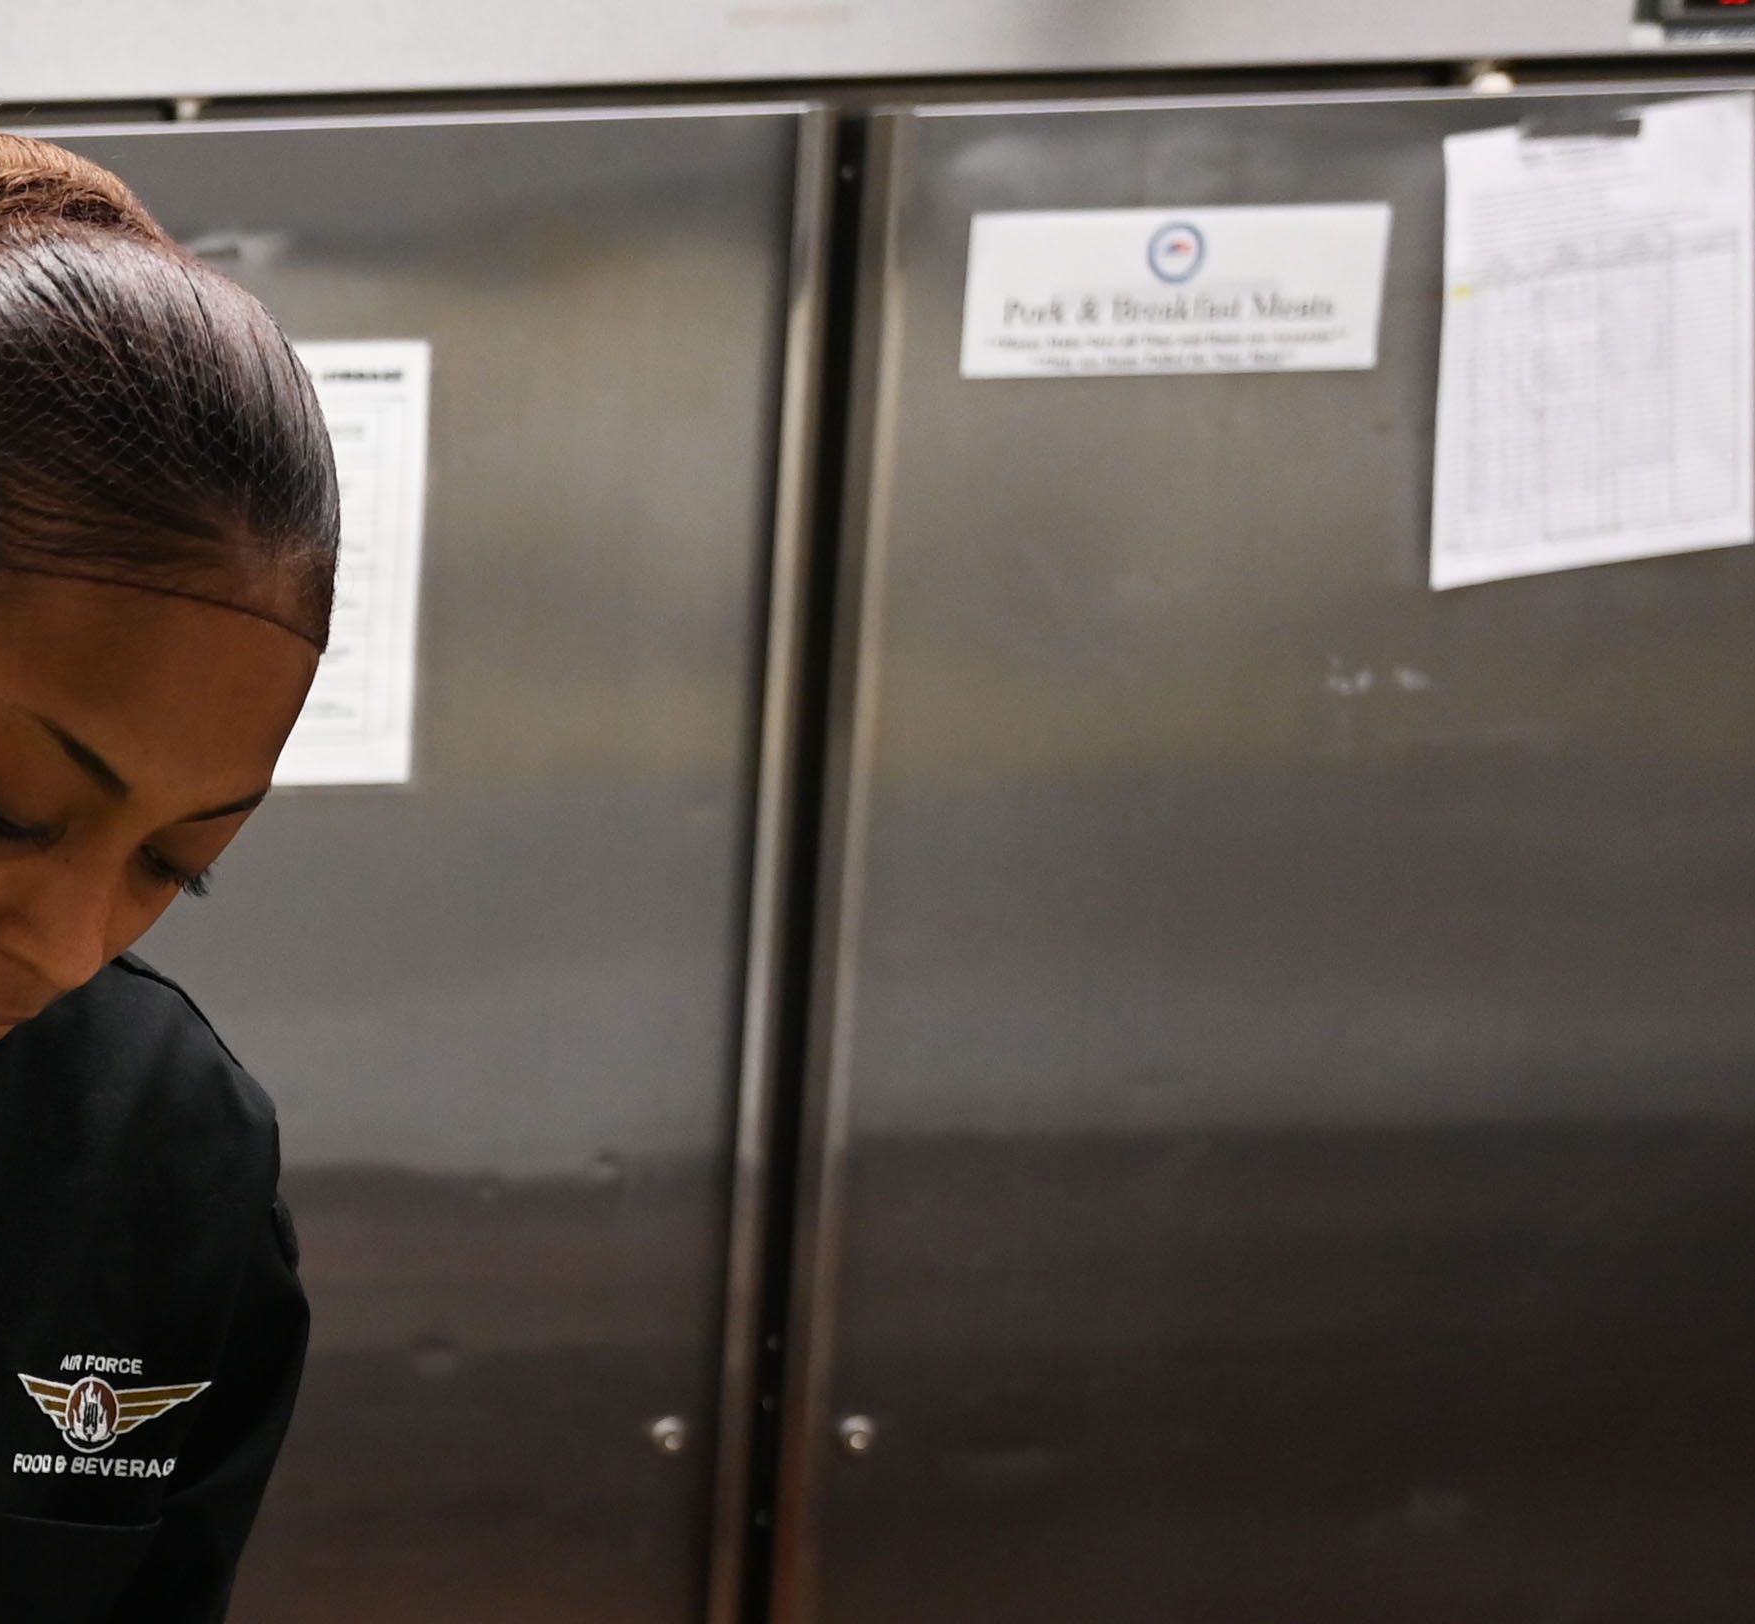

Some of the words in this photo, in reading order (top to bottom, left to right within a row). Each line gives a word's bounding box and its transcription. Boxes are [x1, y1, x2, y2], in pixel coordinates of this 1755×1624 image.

[1002, 296, 1065, 325] Pork
[1076, 296, 1101, 325] &
[1111, 291, 1240, 323] Breakfast
[1252, 289, 1336, 321] Meats
[60, 1354, 82, 1372] AIR
[85, 1355, 143, 1376] FORCE
[13, 1453, 51, 1474] FOOD
[70, 1456, 178, 1479] BEVERAG
